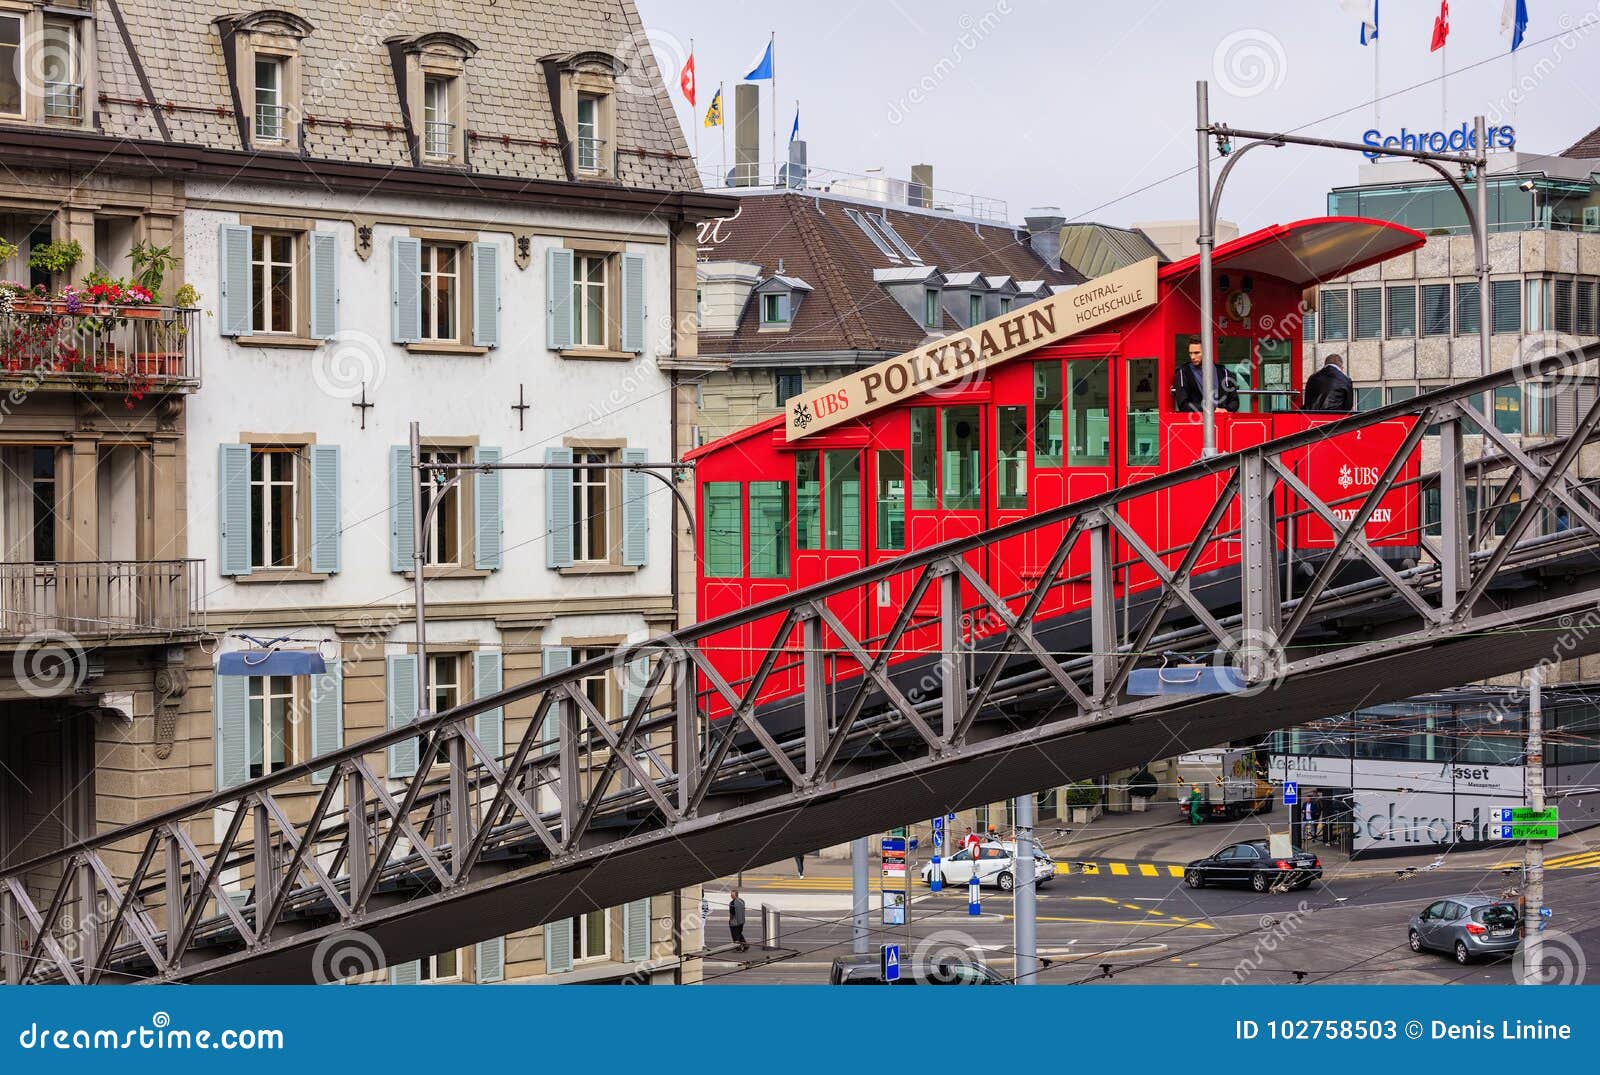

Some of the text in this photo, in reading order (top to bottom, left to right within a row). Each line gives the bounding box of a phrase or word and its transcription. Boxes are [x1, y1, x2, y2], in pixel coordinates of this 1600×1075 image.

[1073, 283, 1123, 308] CENTRAL-
[1076, 289, 1143, 324] HOCHSCHULE
[812, 303, 1058, 420] UBS POLYBAHN
[1354, 467, 1379, 485] UBS
[1331, 508, 1392, 523] OLYHN
